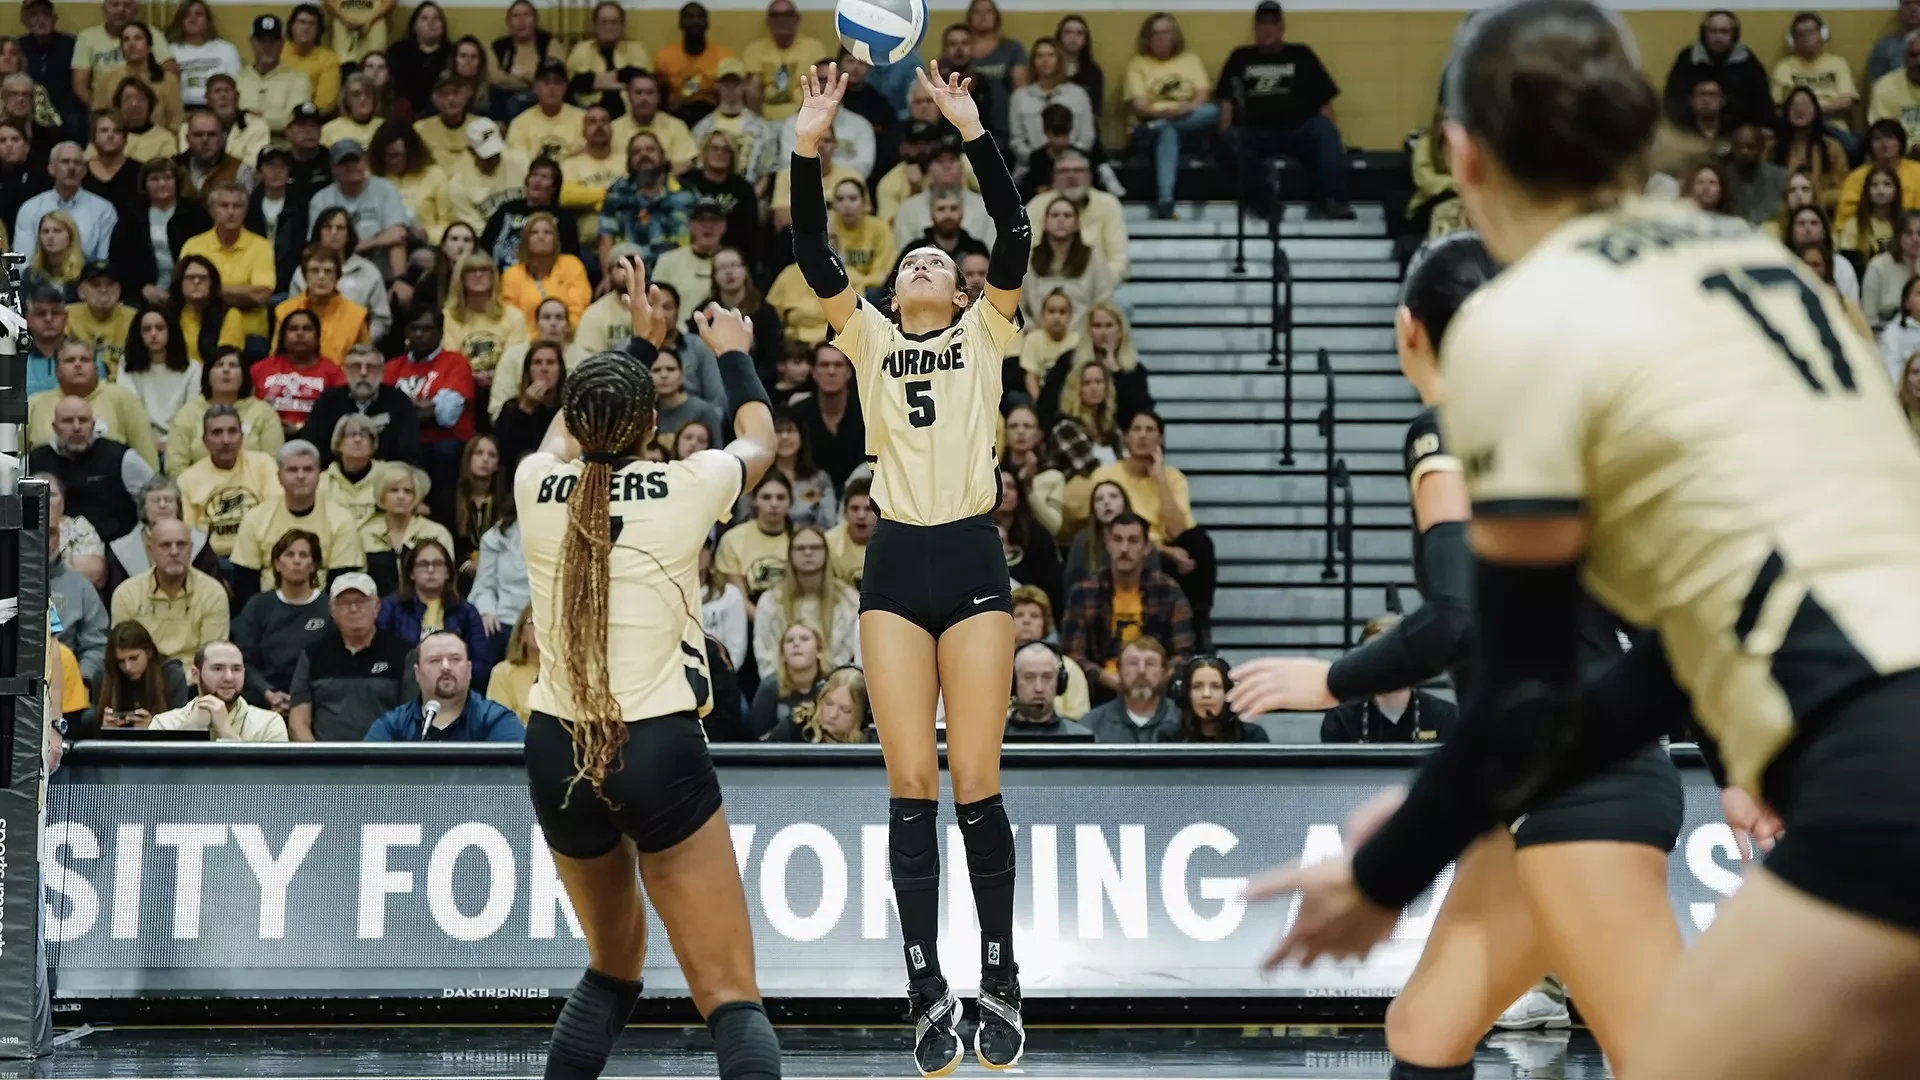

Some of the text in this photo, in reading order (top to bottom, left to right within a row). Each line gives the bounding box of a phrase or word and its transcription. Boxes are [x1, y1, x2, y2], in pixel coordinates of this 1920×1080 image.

[1701, 266, 1857, 393] 17
[881, 342, 965, 378] PURDUE
[905, 380, 936, 428] 5
[537, 471, 669, 503] BOERS
[443, 988, 550, 998] DAKTRONICS
